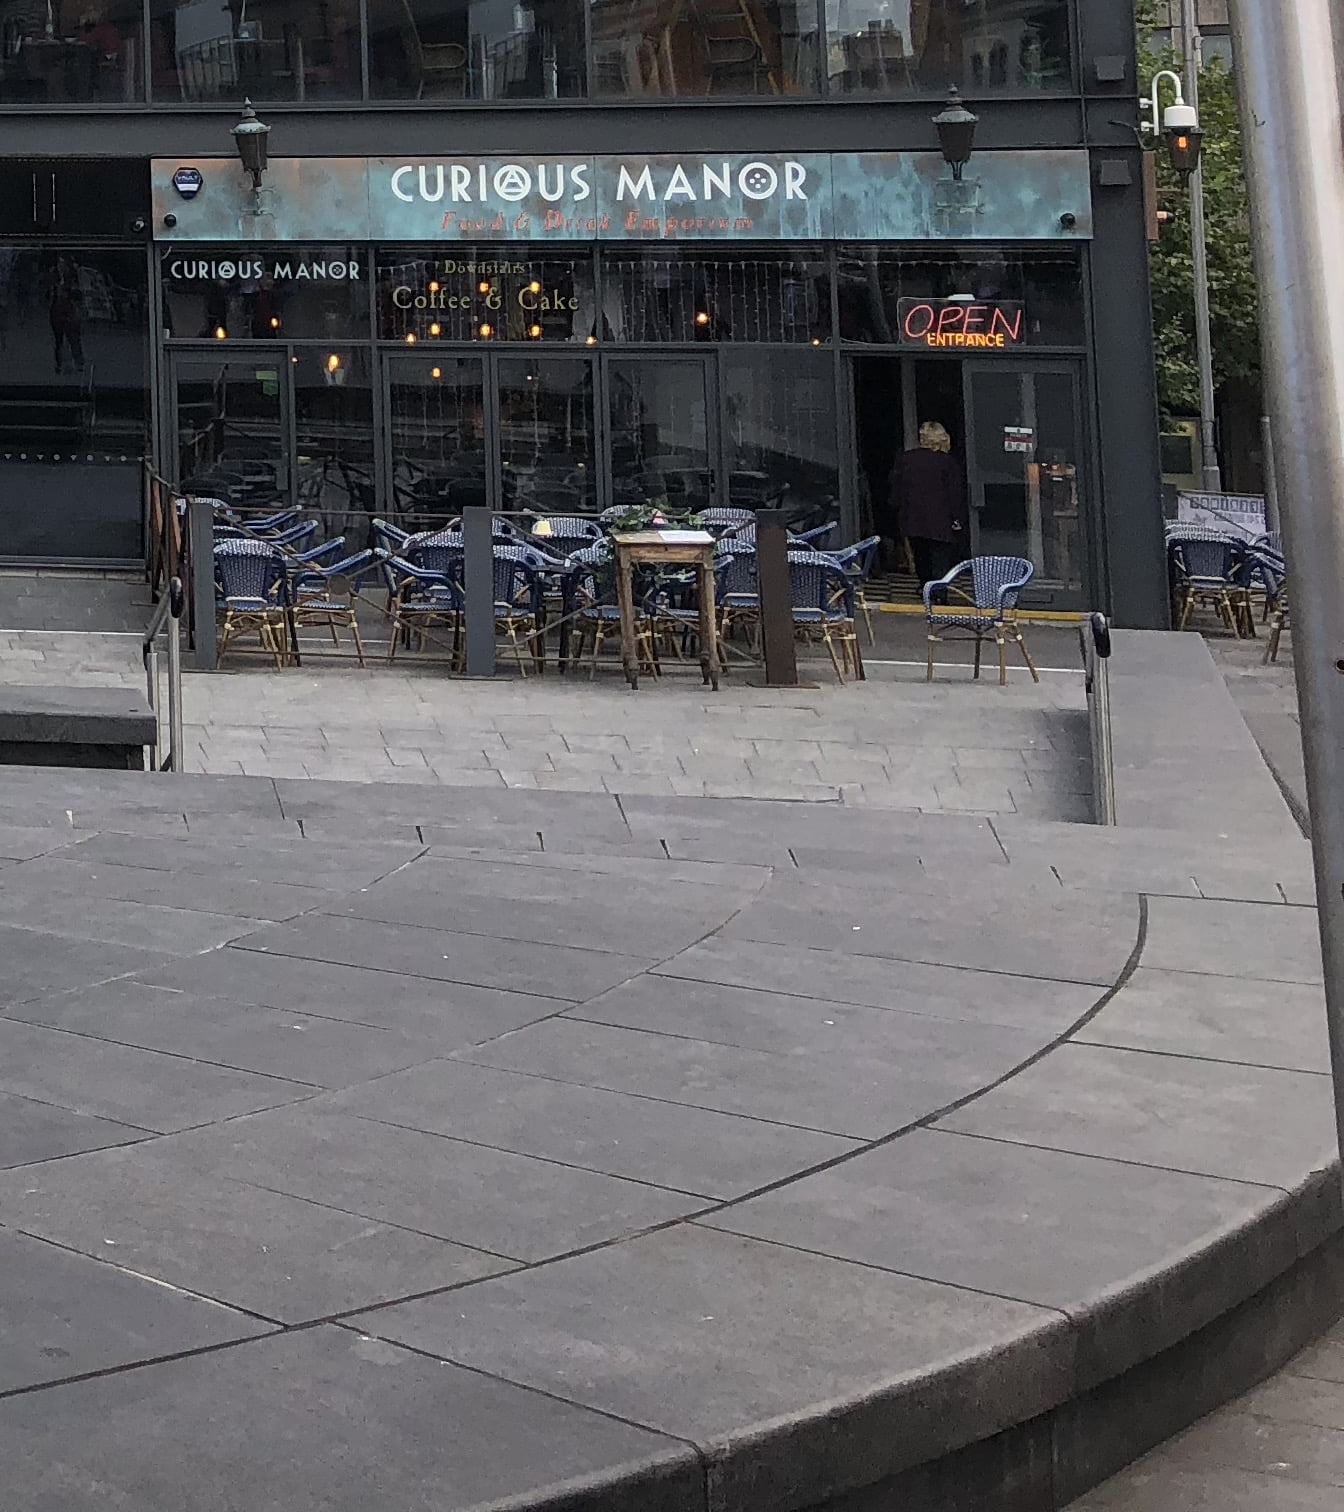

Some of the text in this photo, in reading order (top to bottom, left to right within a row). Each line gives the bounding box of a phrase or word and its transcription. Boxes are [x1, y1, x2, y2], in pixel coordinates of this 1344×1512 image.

[616, 161, 808, 201] MANOR
[273, 260, 361, 281] MANOR
[444, 260, 526, 275] Downstairs
[392, 286, 580, 311] Coffee & Cake
[905, 304, 1022, 340] OPEN
[927, 333, 1005, 347] ENTRANCE
